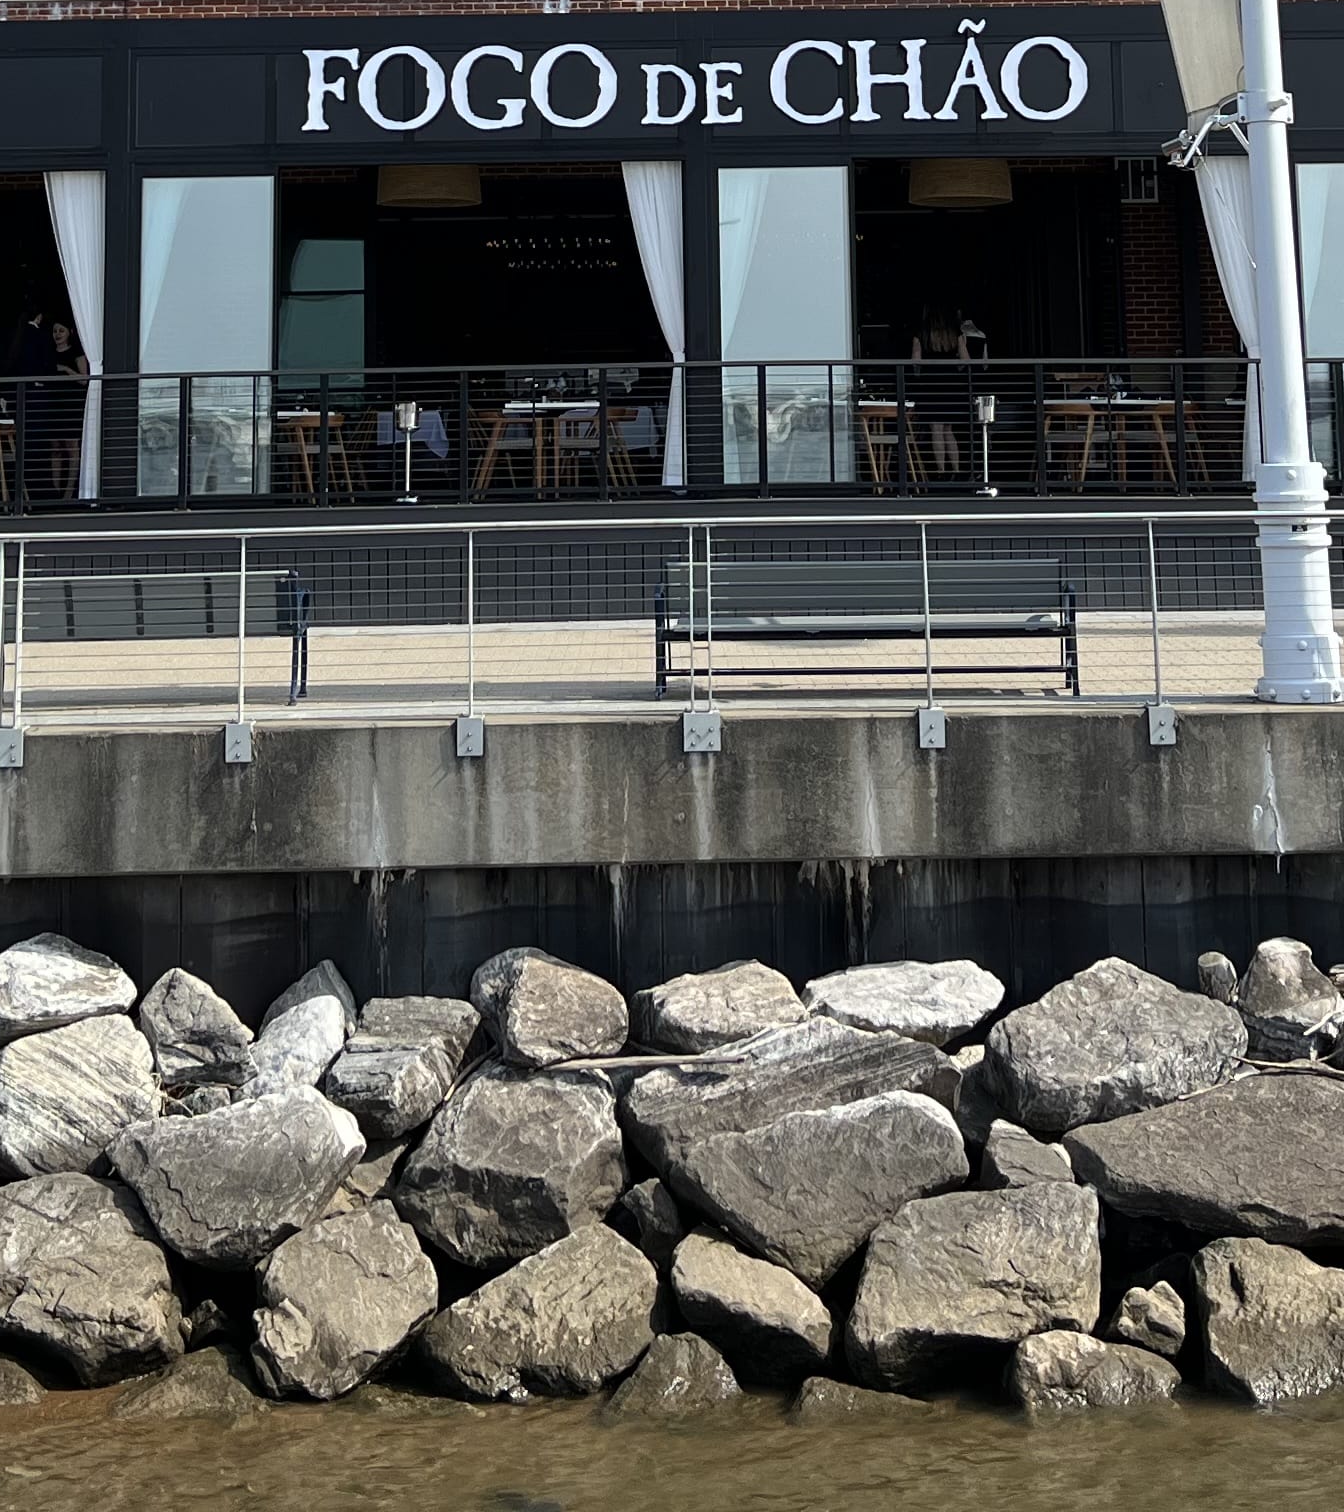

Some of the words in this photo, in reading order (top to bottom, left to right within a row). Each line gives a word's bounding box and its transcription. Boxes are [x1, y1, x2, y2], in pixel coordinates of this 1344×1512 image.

[301, 44, 618, 131] FOGO
[640, 61, 743, 125] DE
[769, 18, 1089, 124] CHÃO
